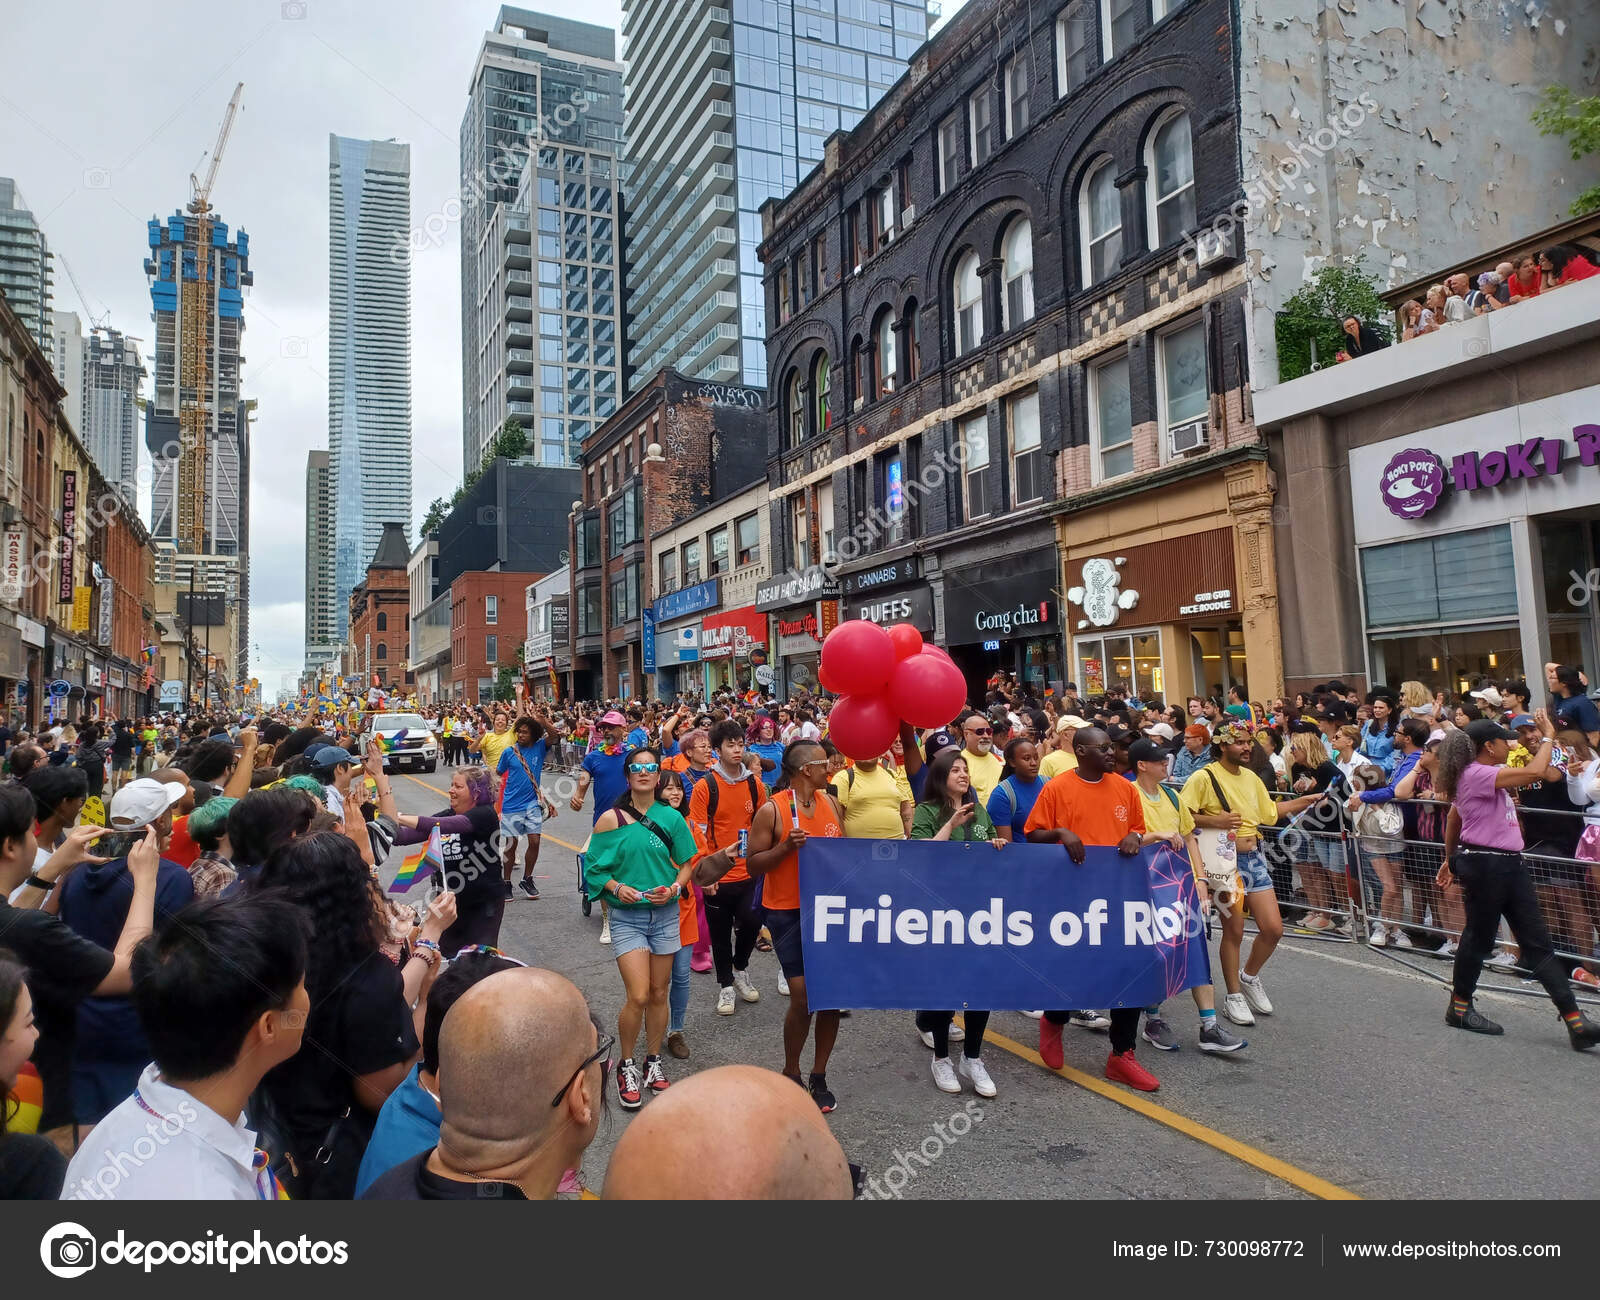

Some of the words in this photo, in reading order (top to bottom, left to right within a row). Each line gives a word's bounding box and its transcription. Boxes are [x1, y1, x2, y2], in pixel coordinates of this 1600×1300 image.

[1387, 464, 1408, 482] HOKI
[1452, 437, 1564, 491] HOKI
[757, 585, 780, 605] DREAM
[780, 580, 798, 599] HAIR
[798, 572, 823, 595] SALON
[857, 566, 897, 589] CANNABIS
[860, 598, 913, 623] PUFFS
[976, 610, 1012, 634] Gong
[1013, 603, 1039, 626] cha
[984, 640, 1000, 651] OPEN
[1204, 869, 1230, 882] ibrary
[813, 894, 1034, 946] Friends
[1049, 898, 1108, 947] of
